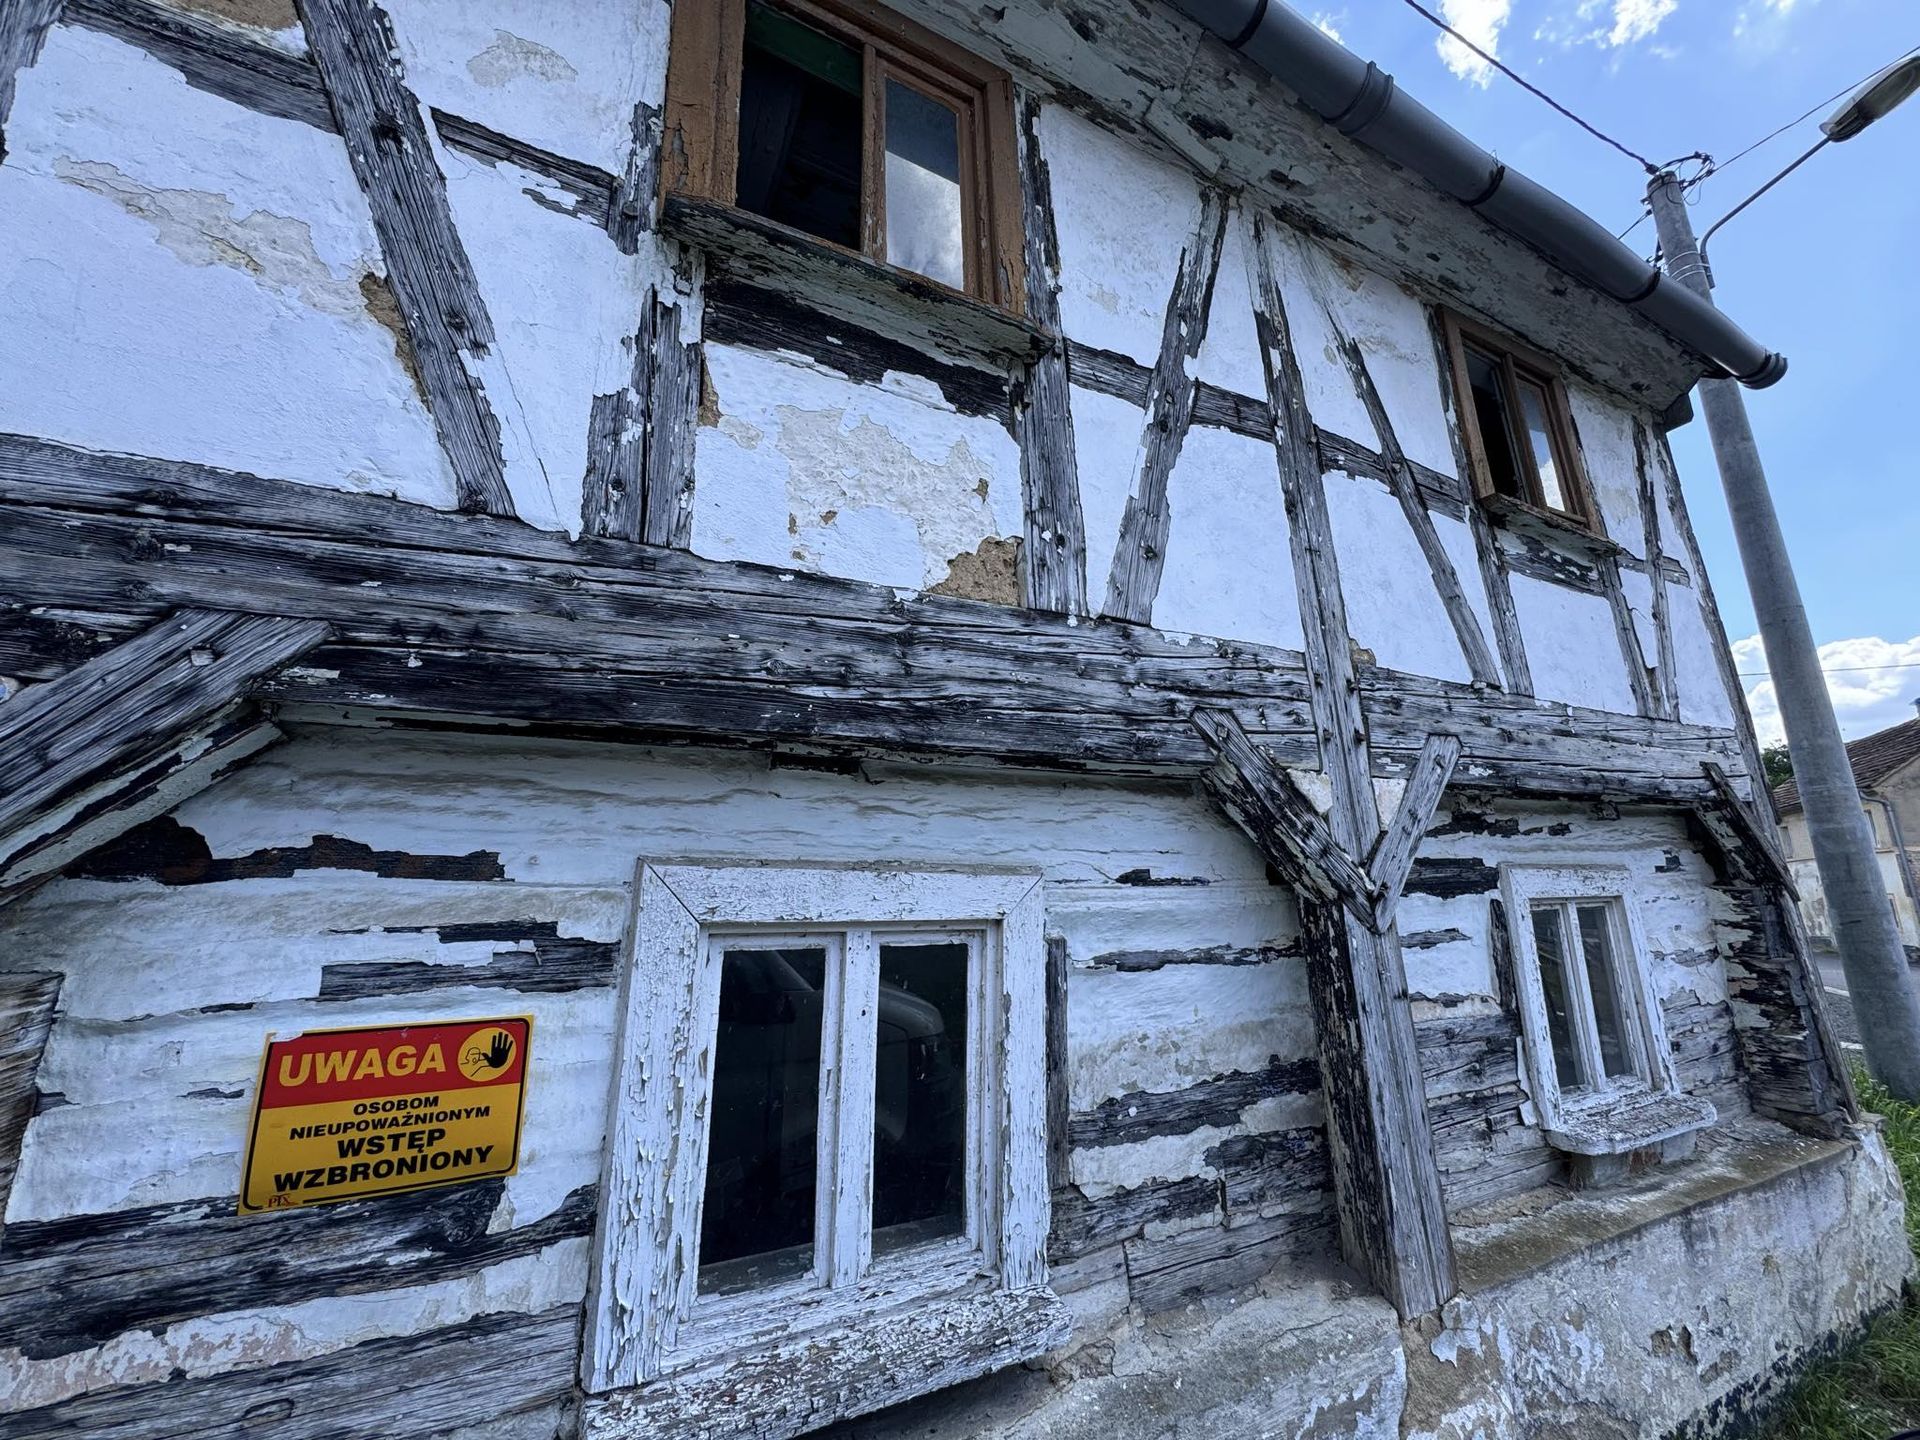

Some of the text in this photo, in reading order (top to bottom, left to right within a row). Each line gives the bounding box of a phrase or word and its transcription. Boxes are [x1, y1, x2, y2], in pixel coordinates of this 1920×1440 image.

[279, 1043, 446, 1087] UWAGA
[289, 1105, 490, 1141] NIEUPOWAŻNIONYM
[353, 1095, 440, 1116] OSOBOM
[337, 1128, 446, 1159] WSTĘP
[273, 1144, 494, 1193] WZBRONIONY
